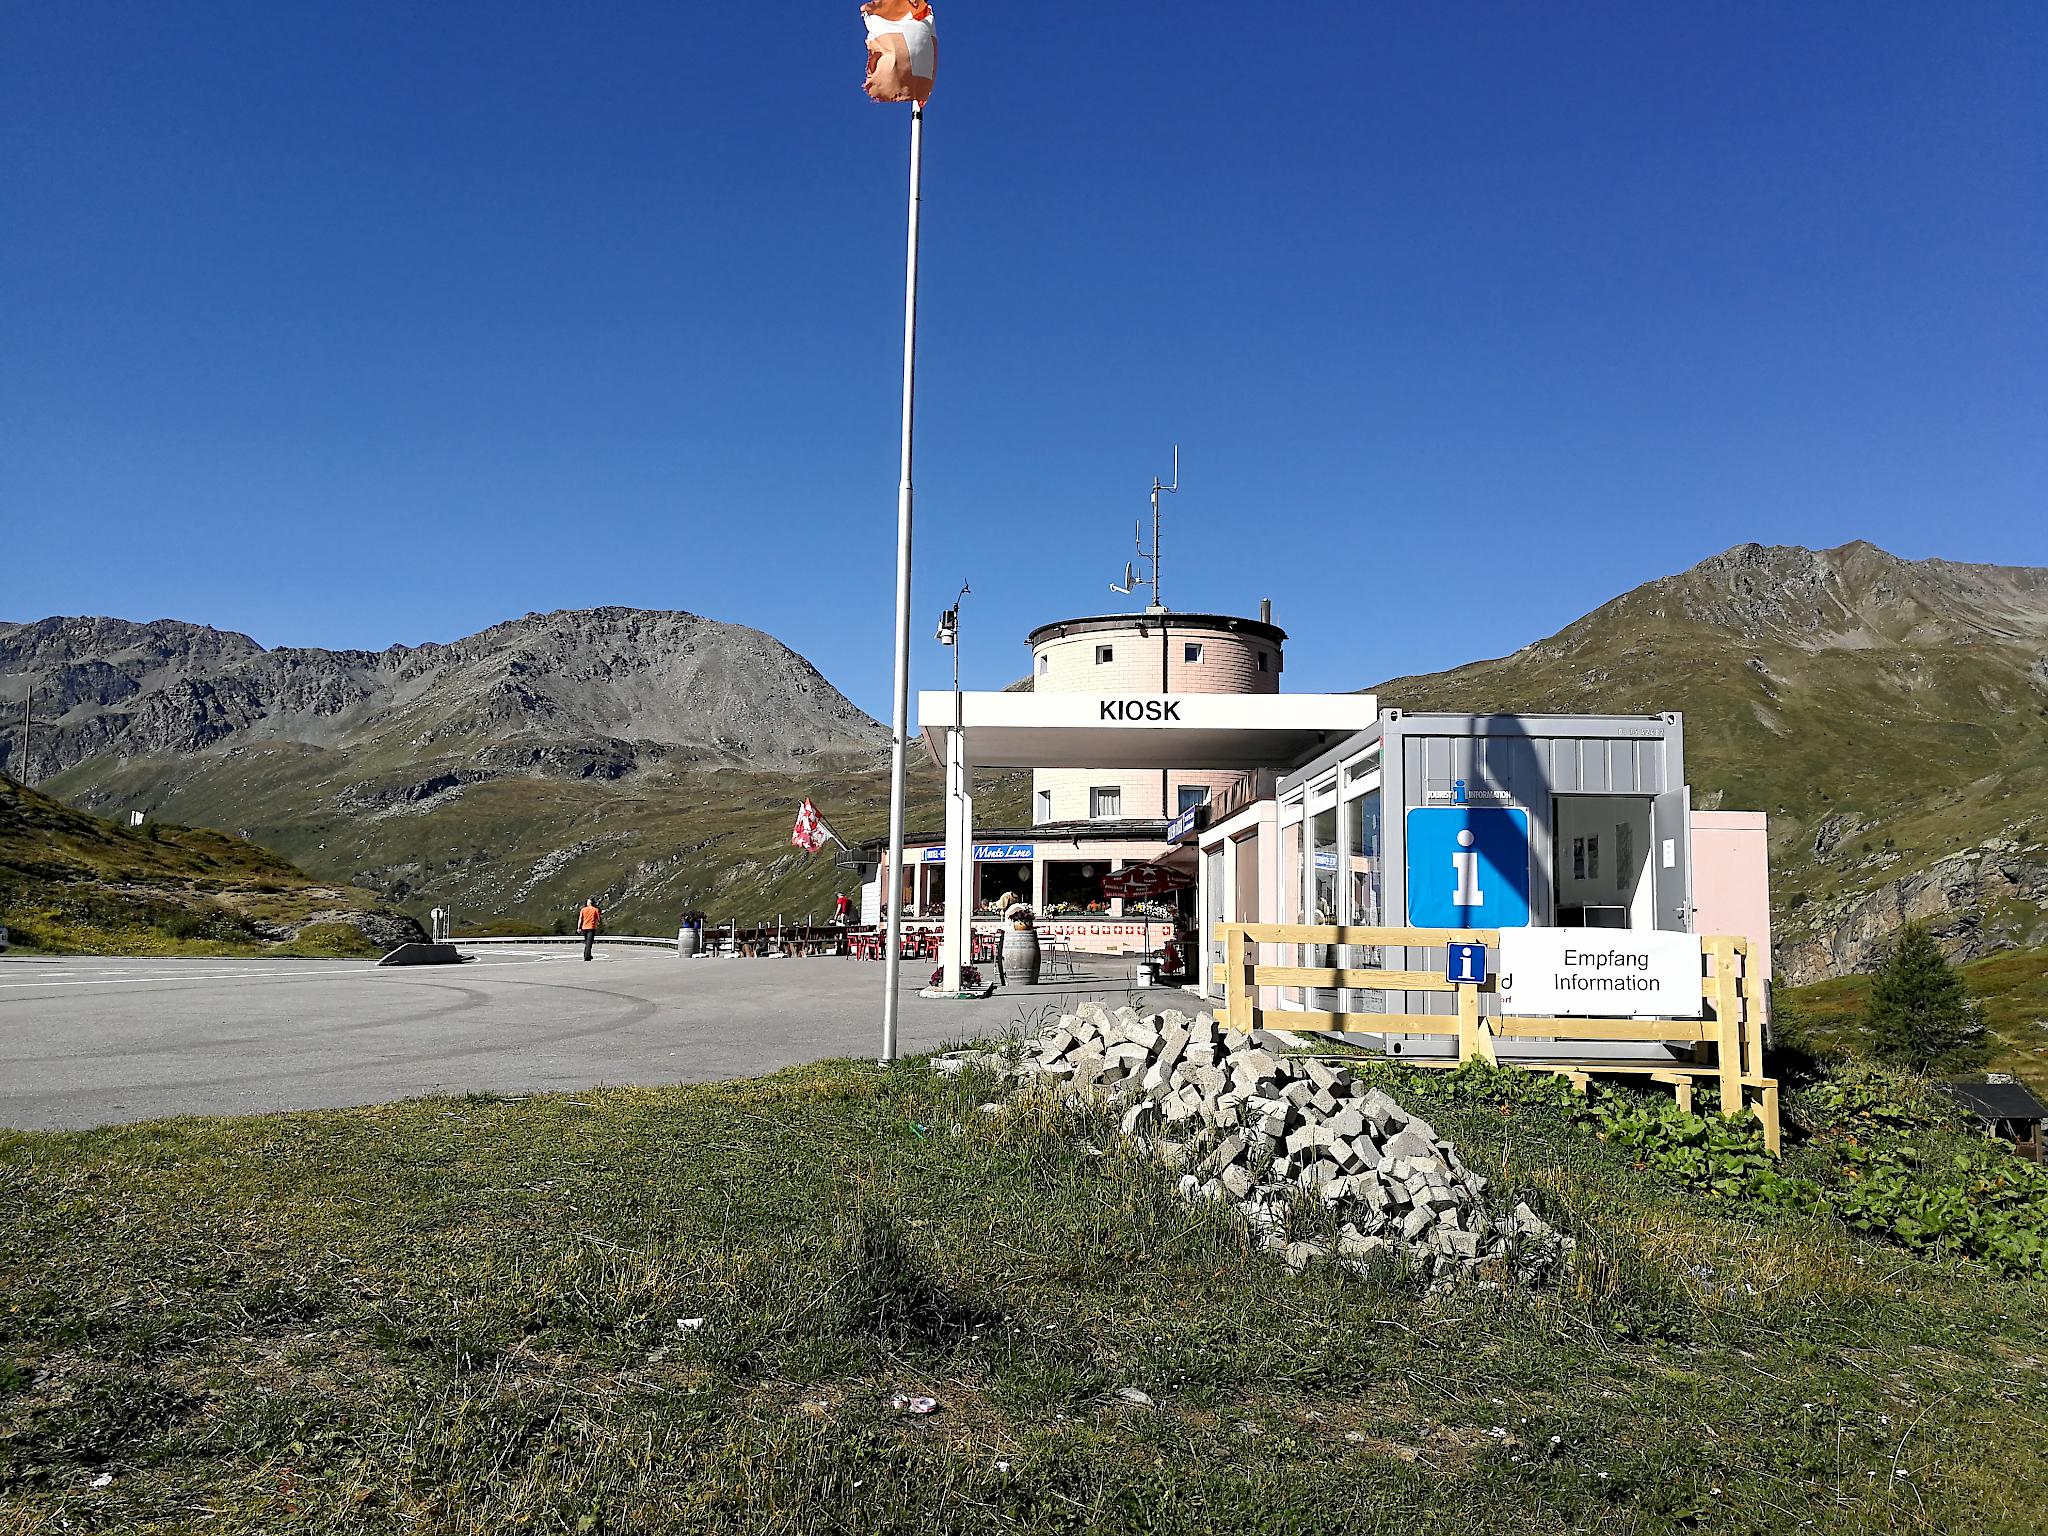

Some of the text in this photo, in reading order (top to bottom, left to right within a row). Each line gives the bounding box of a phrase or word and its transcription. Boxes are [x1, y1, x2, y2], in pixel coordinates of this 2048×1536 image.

[1100, 699, 1181, 721] KIOSK
[1427, 790, 1453, 799] TOURIST
[1468, 790, 1512, 799] INFORMATION
[975, 845, 1032, 859] Monte Leone
[1564, 949, 1649, 971] Empfang
[1554, 973, 1660, 991] Information
